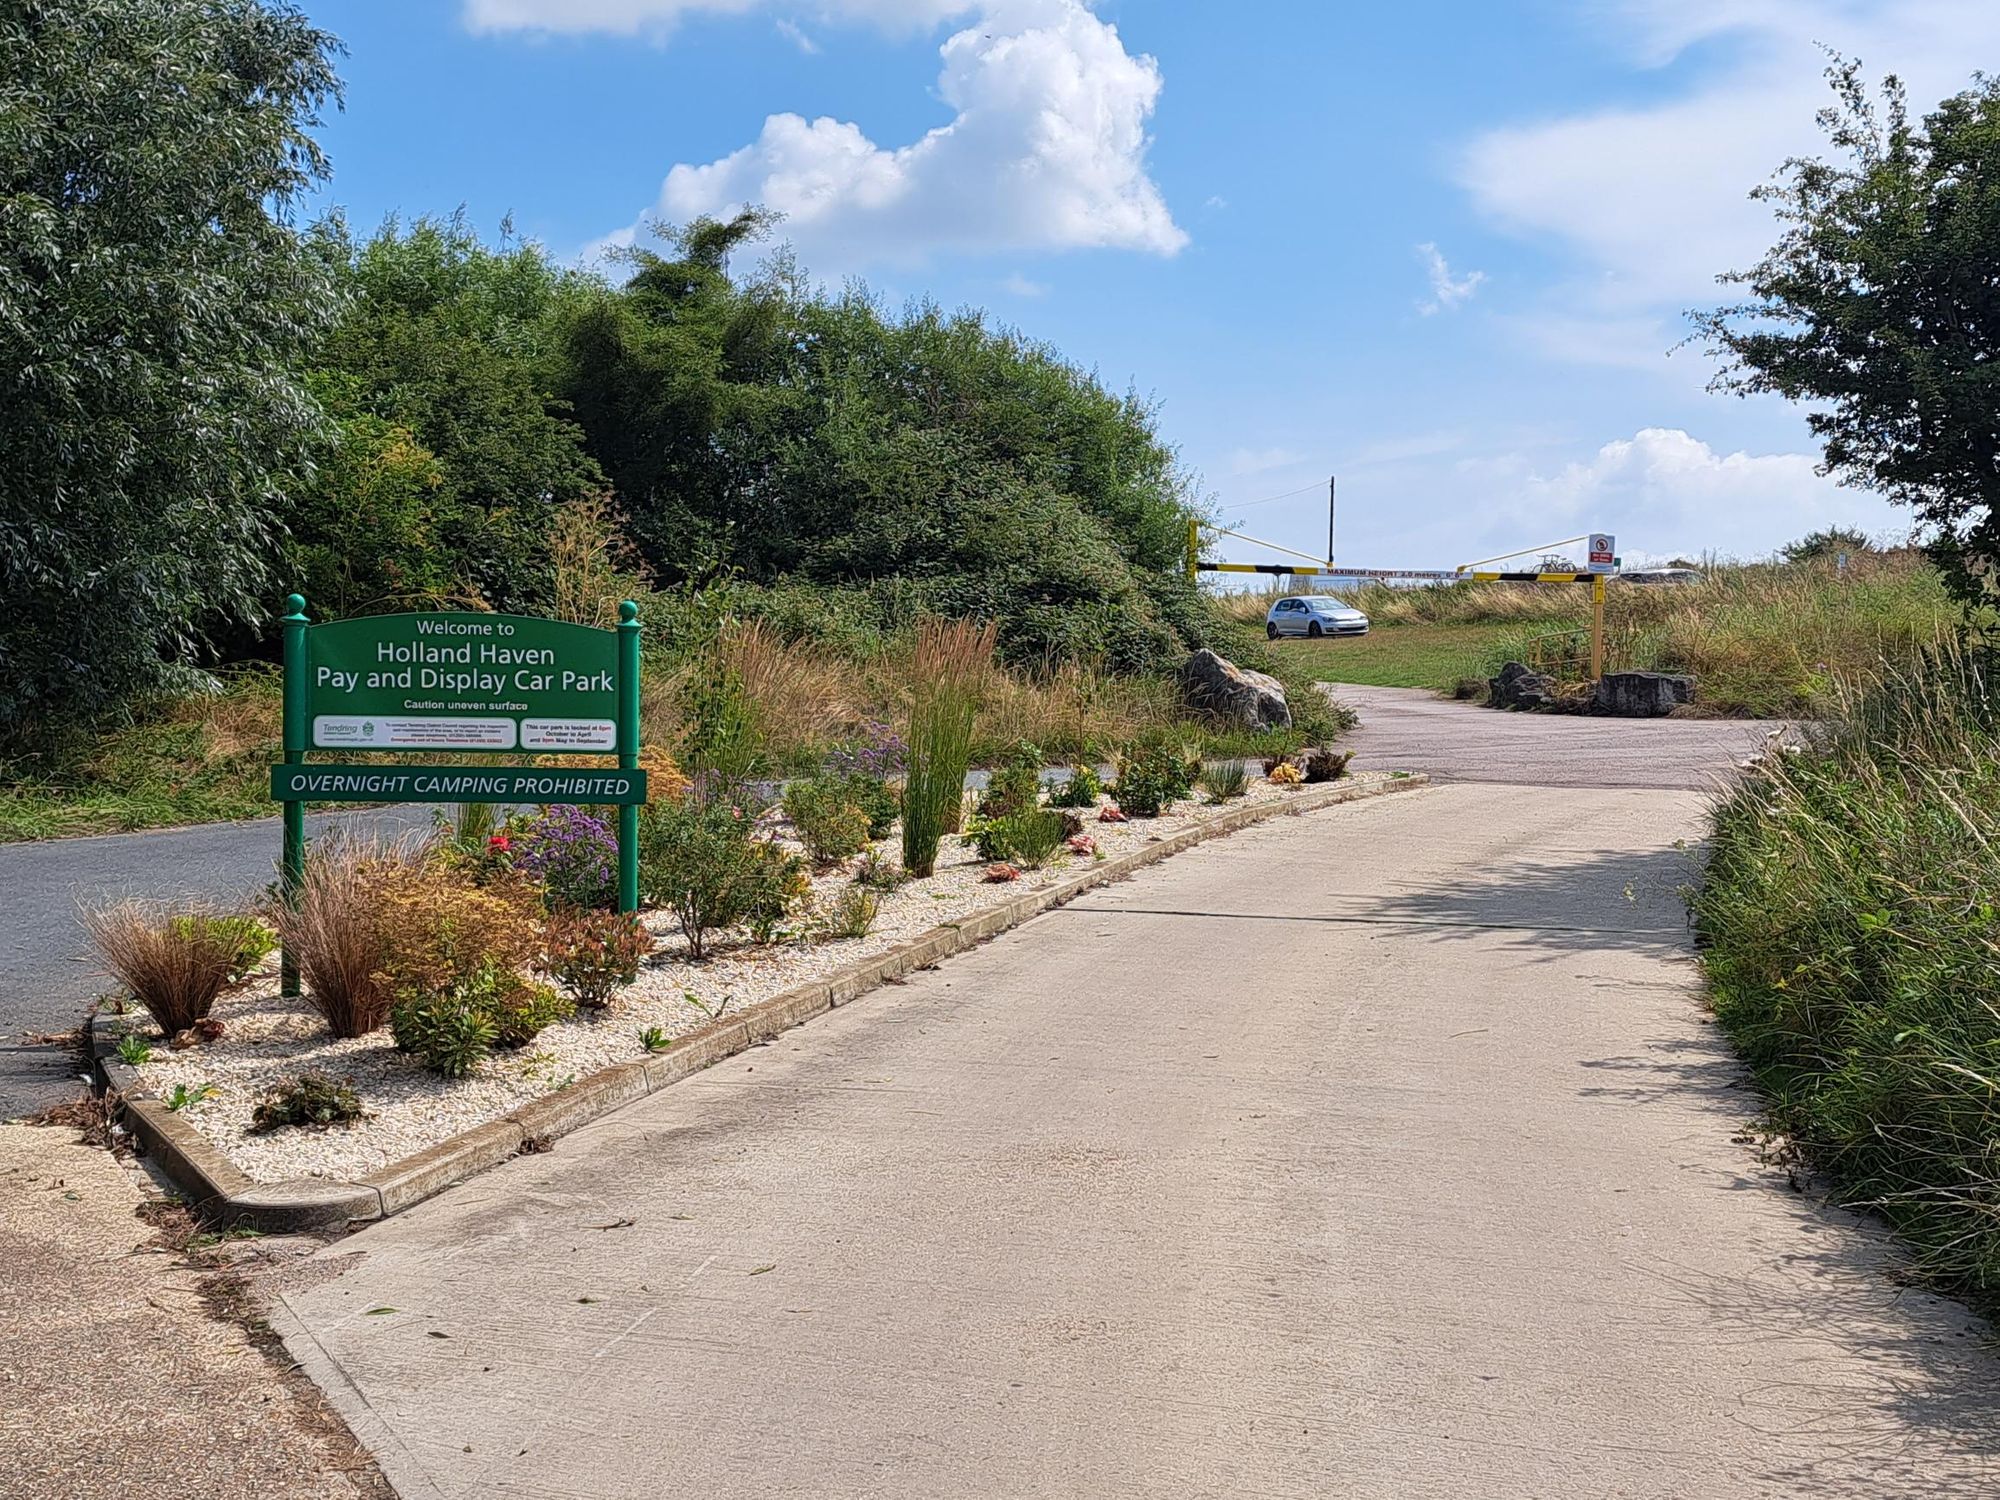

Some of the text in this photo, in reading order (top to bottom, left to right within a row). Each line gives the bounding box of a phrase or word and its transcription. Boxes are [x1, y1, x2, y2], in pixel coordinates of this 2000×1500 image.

[1327, 568, 1367, 577] MAXIMUM
[416, 620, 515, 636] Welcome to
[377, 640, 555, 665] Holland Haven
[317, 666, 615, 695] Pay and Display Car Park
[403, 699, 529, 711] Caution uneven surface
[290, 774, 630, 795] OVERNIGHT CAMPING PROHIBITED
